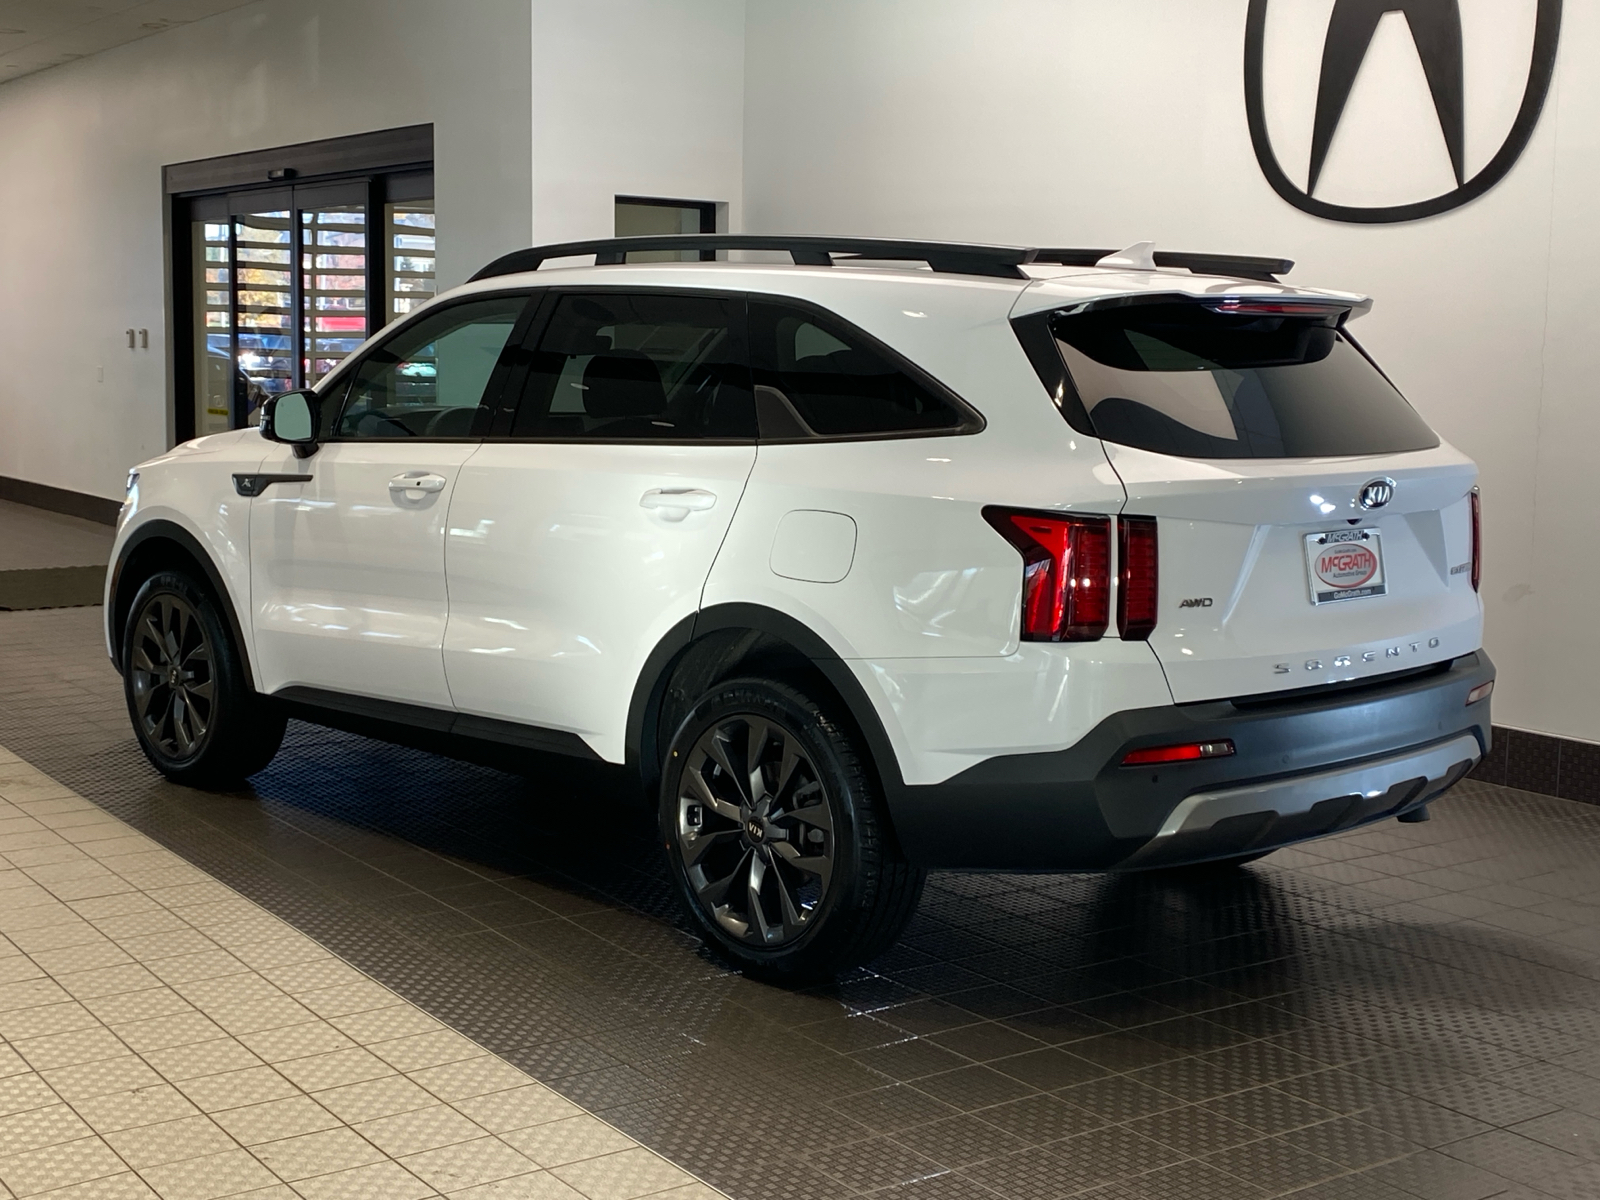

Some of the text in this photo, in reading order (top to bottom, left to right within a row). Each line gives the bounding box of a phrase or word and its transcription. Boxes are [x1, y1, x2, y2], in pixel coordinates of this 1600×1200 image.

[1367, 485, 1391, 503] KIA
[1178, 597, 1213, 608] AWD
[1273, 637, 1440, 675] SORENTO
